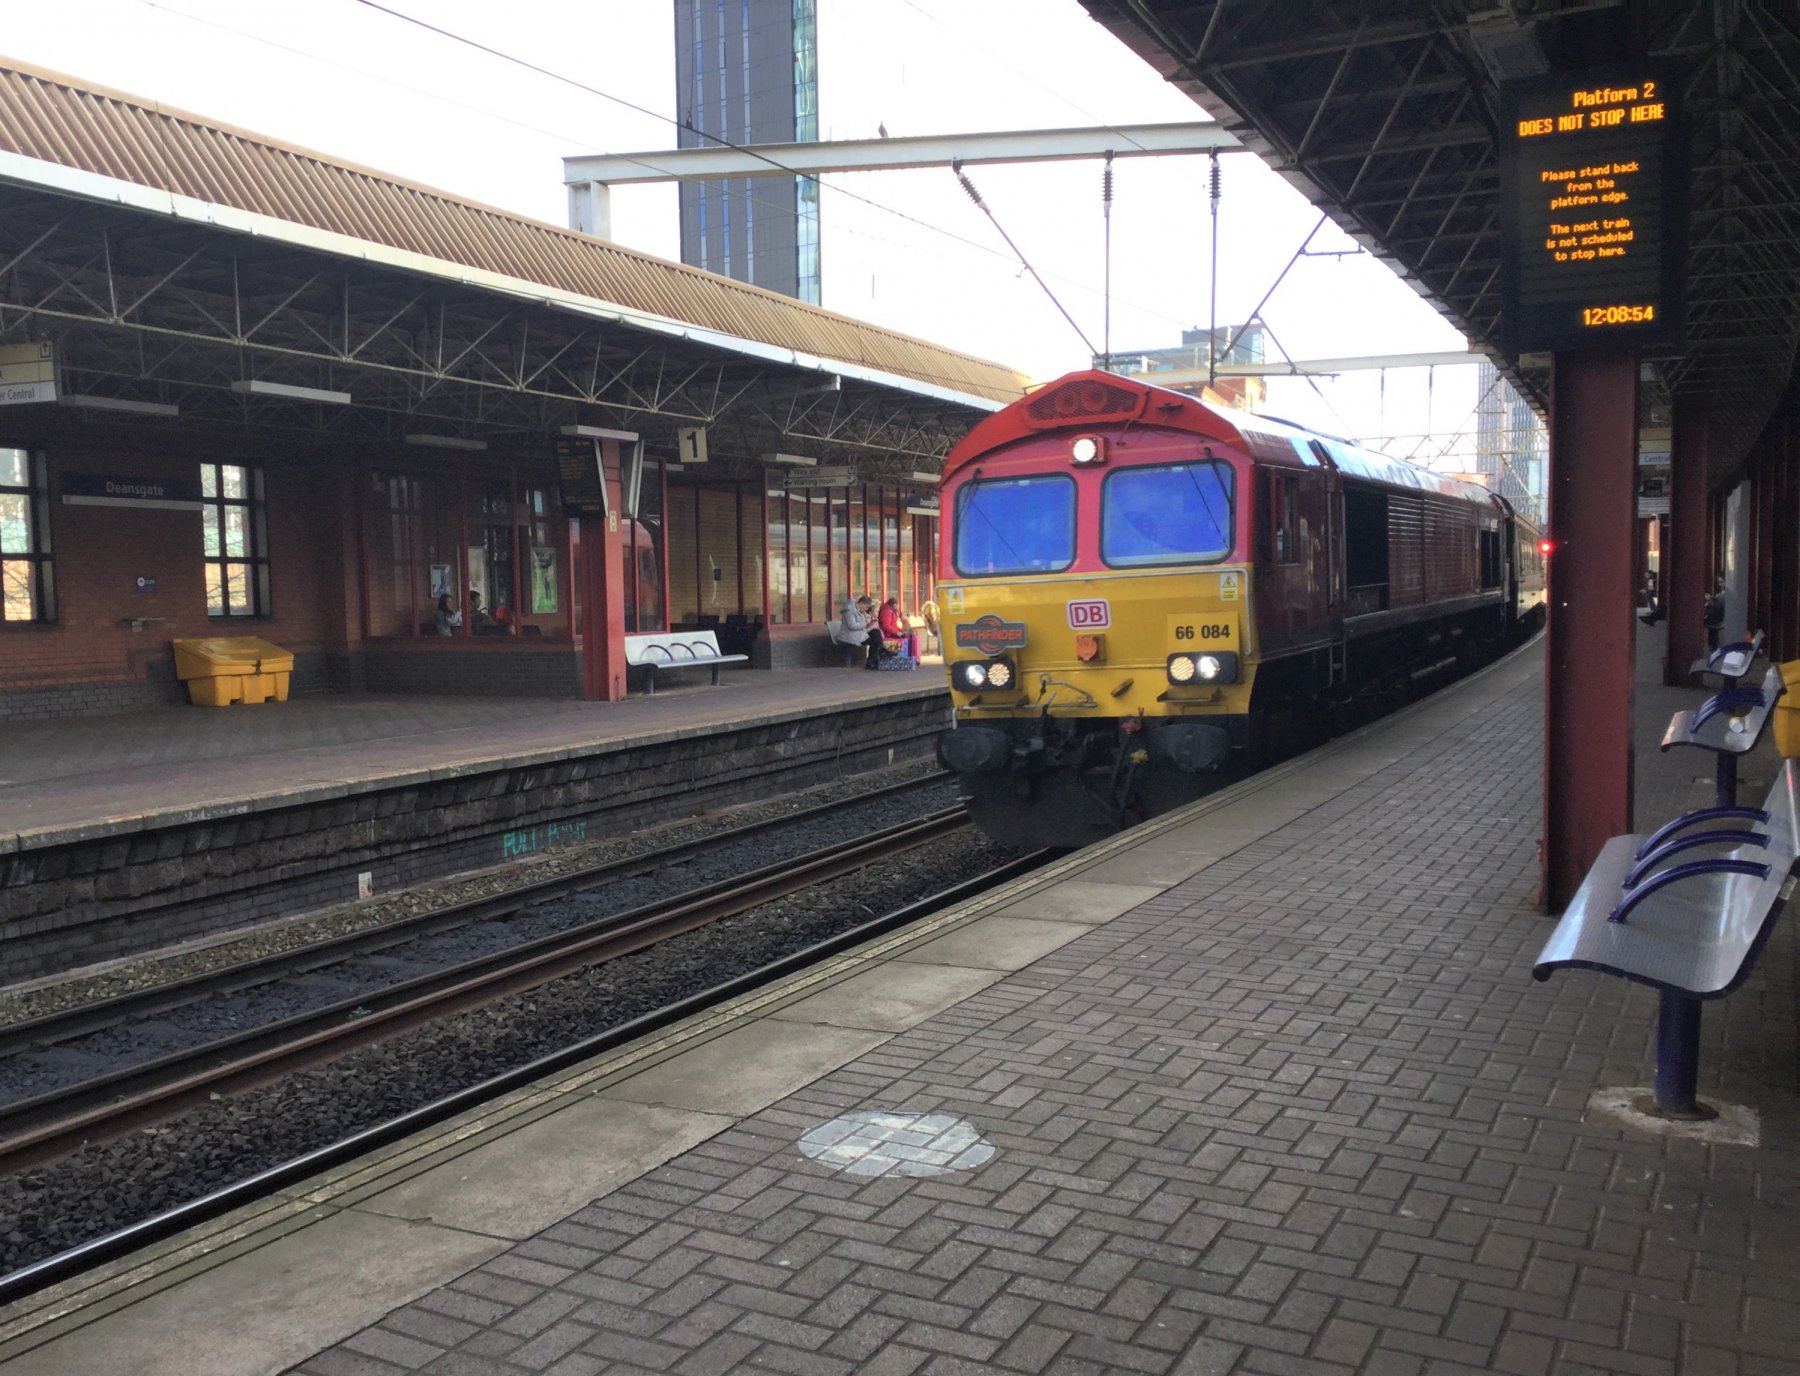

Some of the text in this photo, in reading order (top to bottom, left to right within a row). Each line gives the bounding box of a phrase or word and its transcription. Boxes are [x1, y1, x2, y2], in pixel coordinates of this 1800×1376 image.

[1573, 81, 1655, 108] Platform 2
[1519, 103, 1664, 137] DOES NOT STOP HERE
[1542, 161, 1639, 182] Please stand back
[1567, 179, 1615, 192] from the
[1551, 191, 1629, 210] platform edge.
[1550, 218, 1630, 235] The next train
[1546, 230, 1634, 249] is not scheduled
[1555, 246, 1626, 261] to stop here.
[1584, 305, 1654, 326] 12:08:54
[7, 387, 36, 401] Central
[686, 431, 698, 458] 1
[106, 480, 165, 498] Deansgate
[794, 478, 818, 486] Waiting
[1073, 605, 1104, 624] DB
[958, 629, 1024, 641] PATHFINDER
[1175, 624, 1231, 640] 66 084
